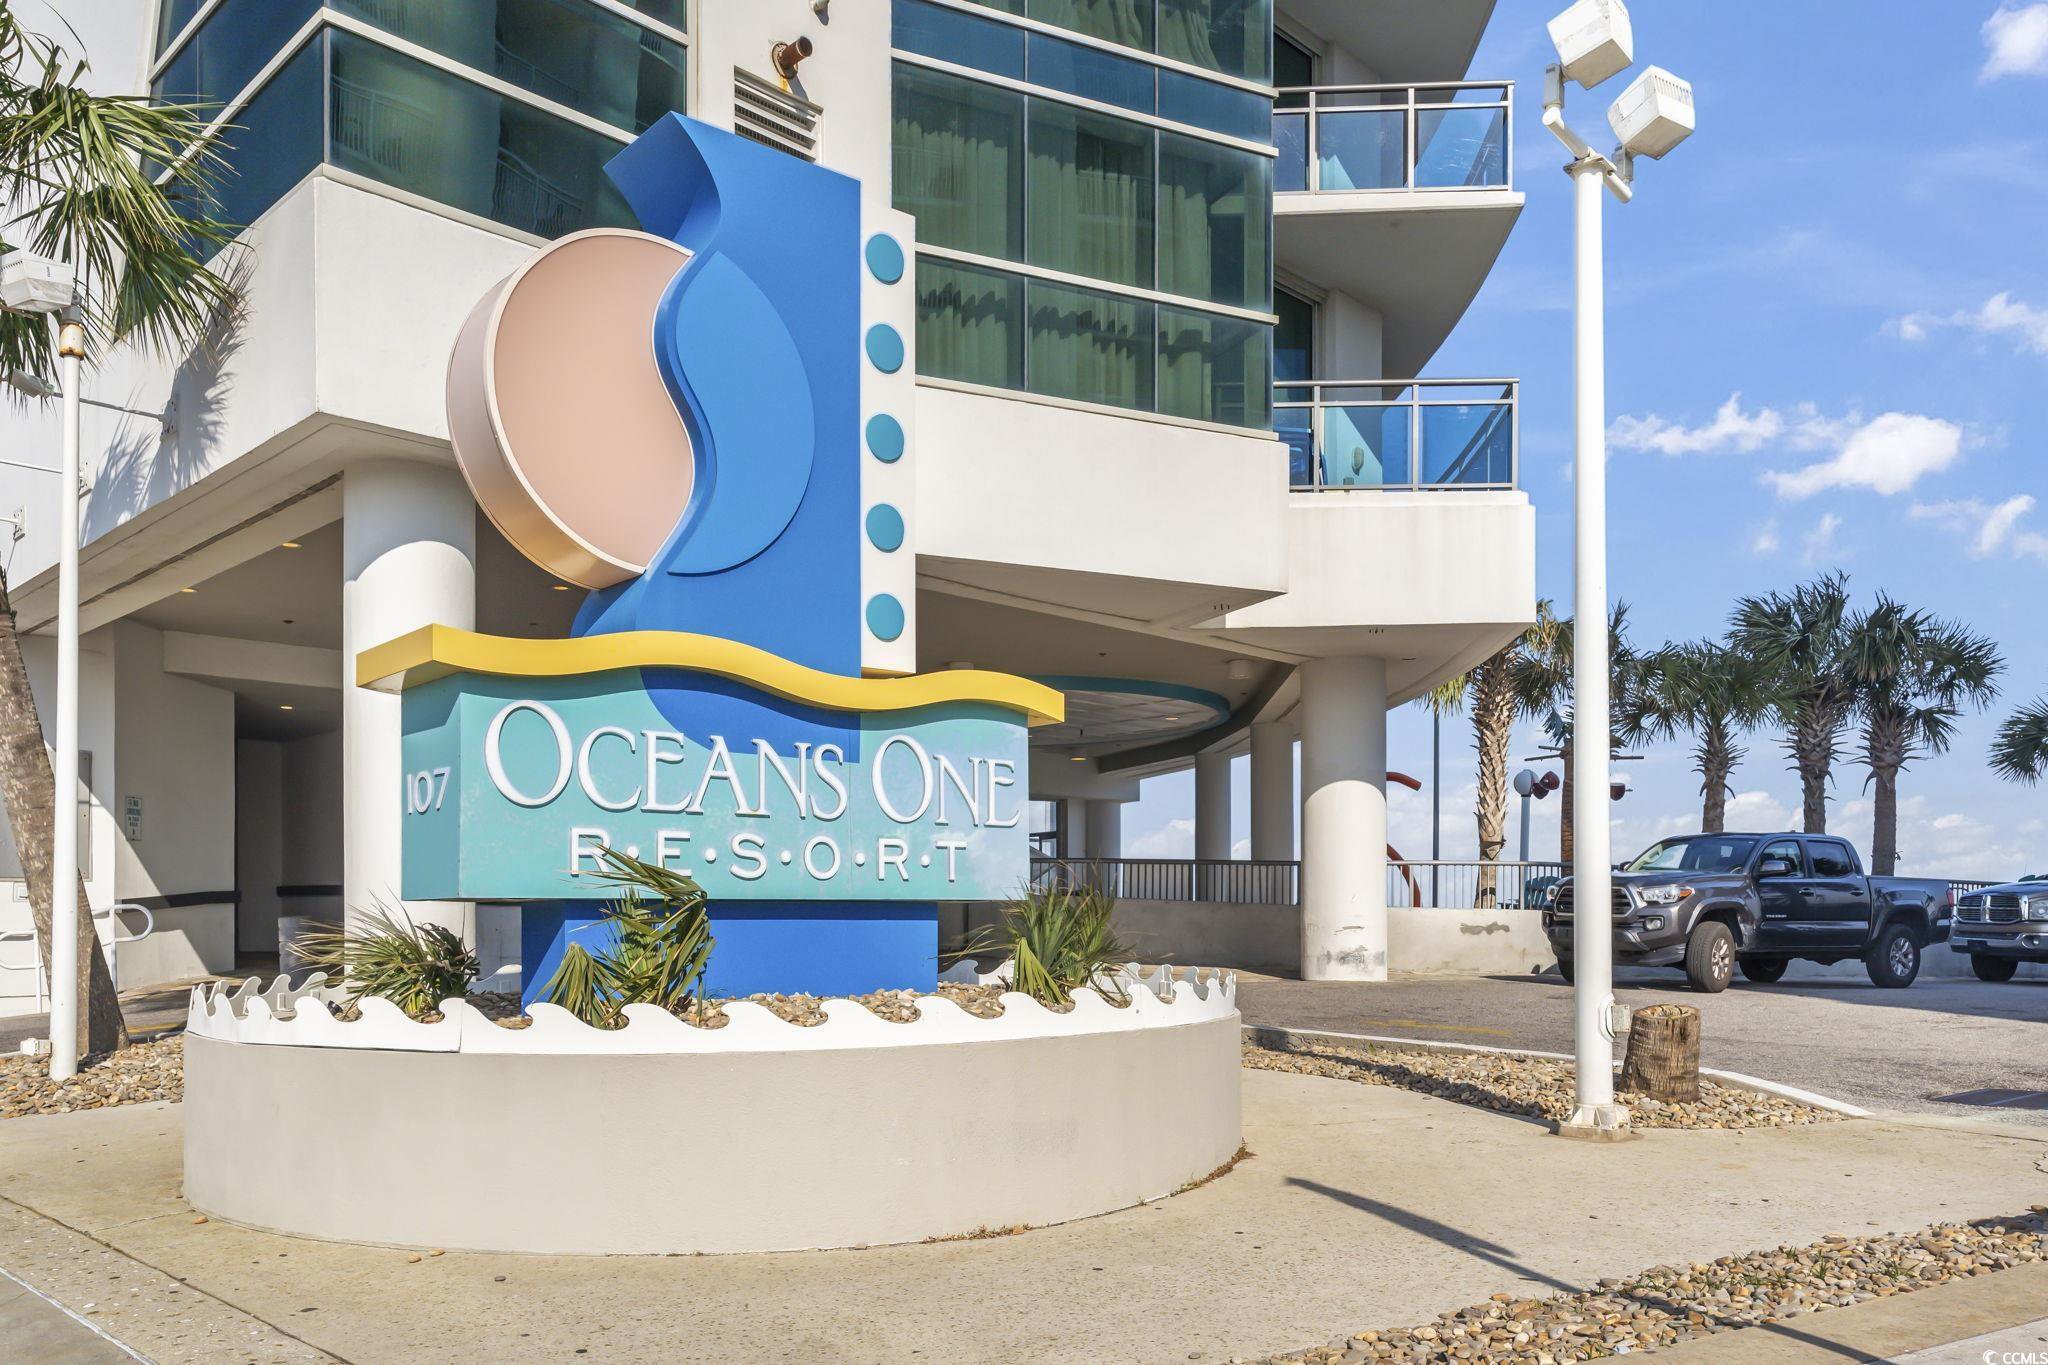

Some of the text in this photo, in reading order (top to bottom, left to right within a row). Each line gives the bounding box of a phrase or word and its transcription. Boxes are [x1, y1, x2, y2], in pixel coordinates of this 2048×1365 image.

[406, 766, 450, 815] 107
[484, 700, 1022, 827] OCEANS ONE
